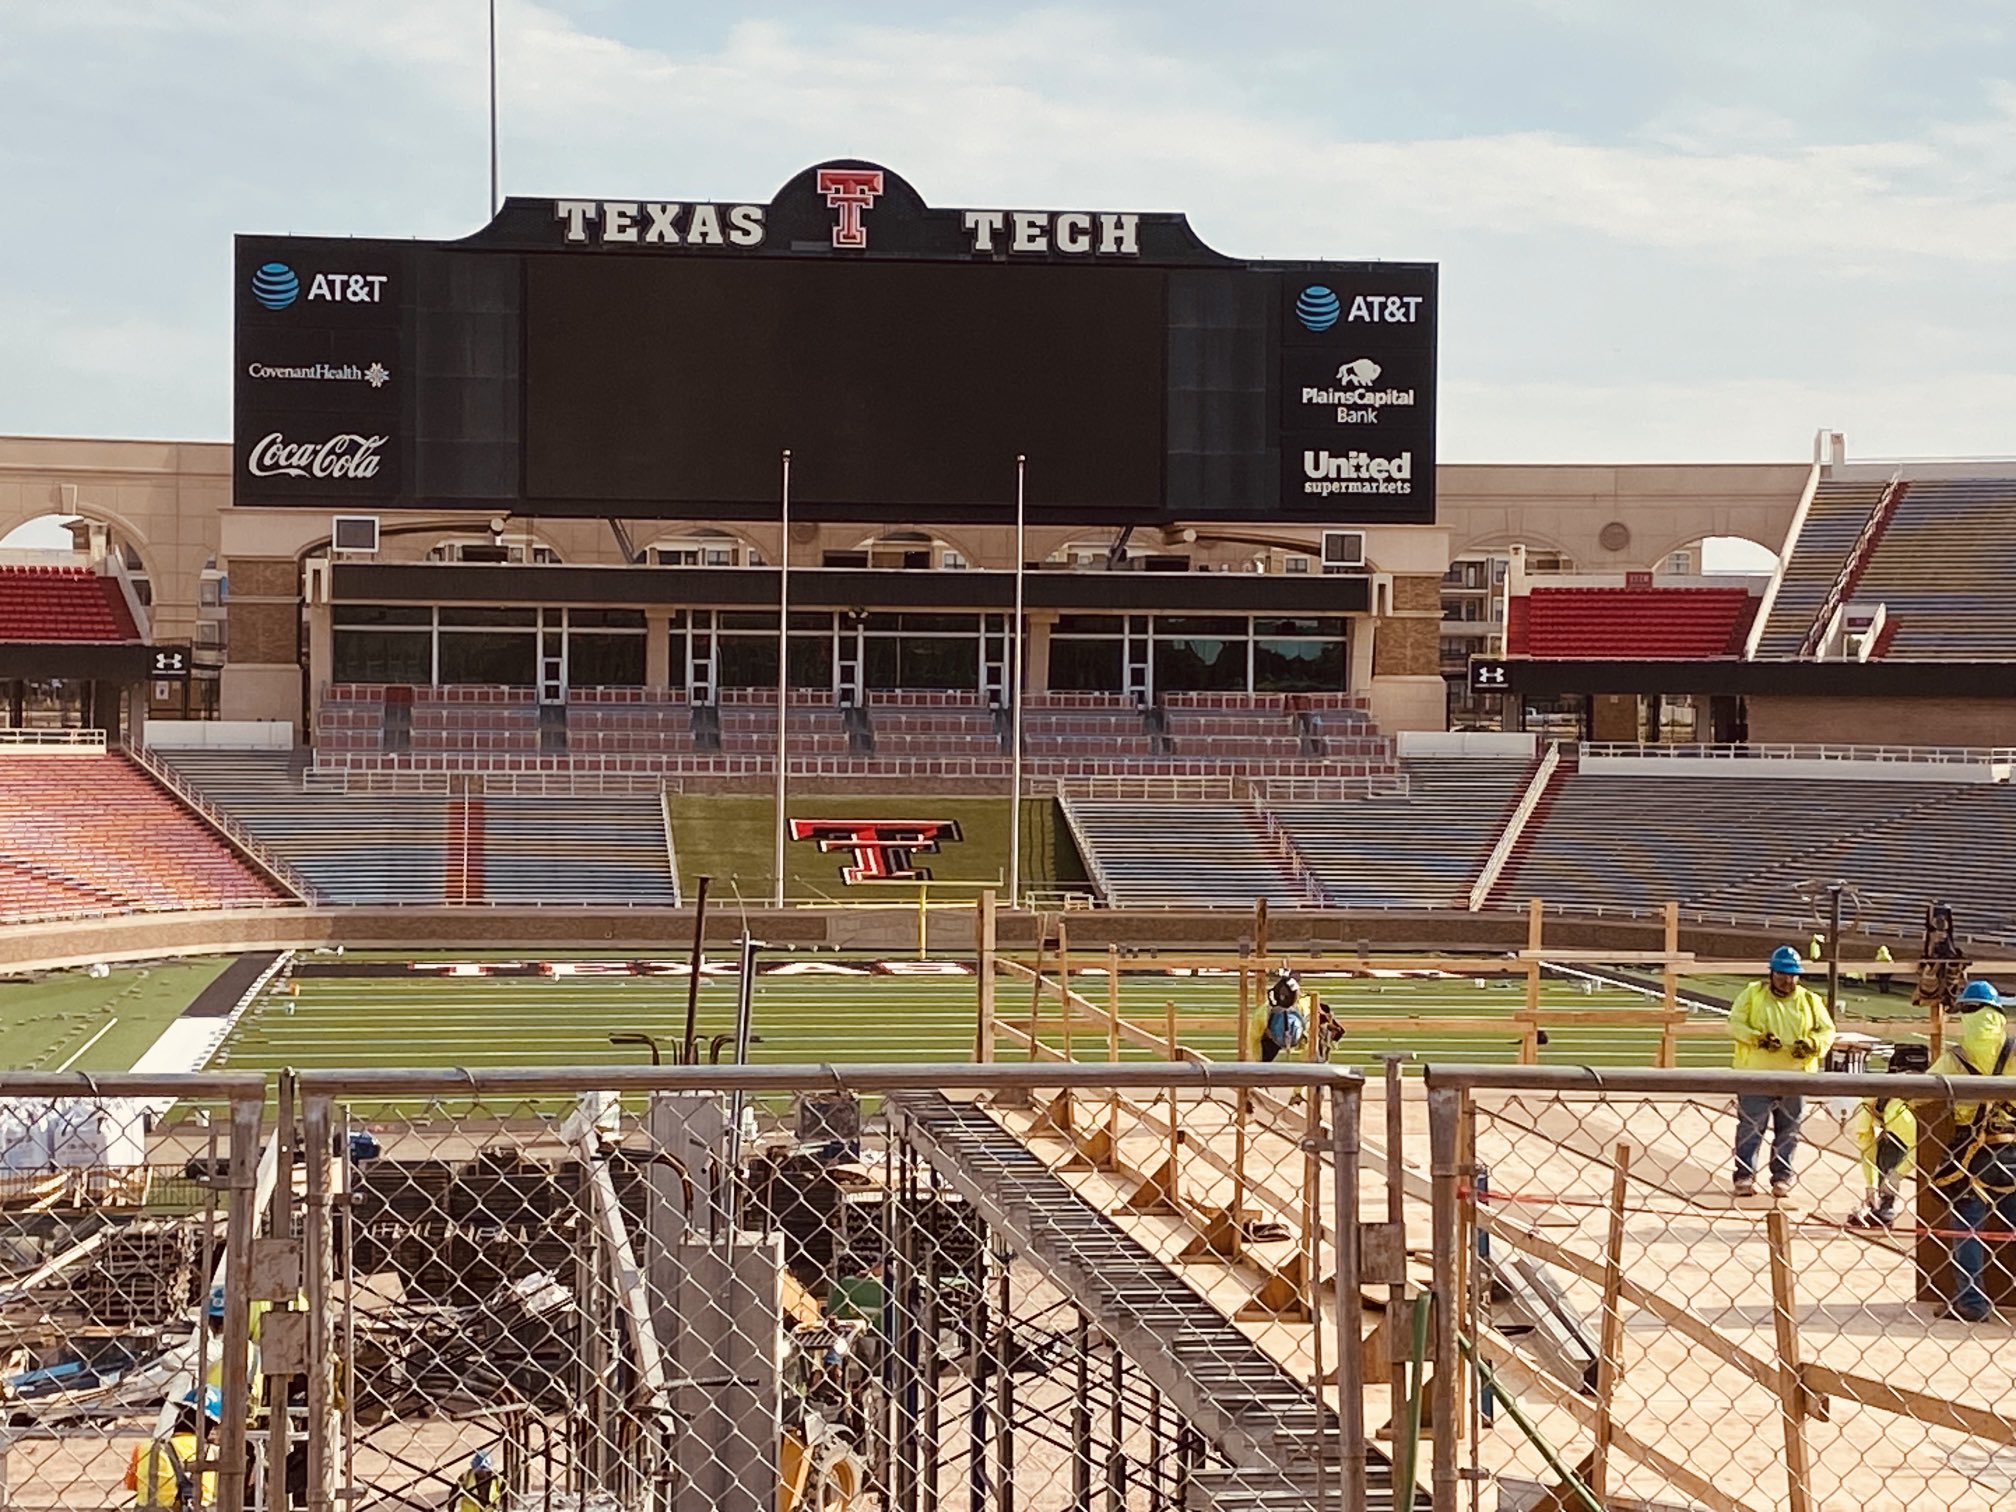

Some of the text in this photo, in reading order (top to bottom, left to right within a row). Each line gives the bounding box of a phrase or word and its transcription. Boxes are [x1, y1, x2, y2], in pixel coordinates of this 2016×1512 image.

[556, 199, 766, 247] TEXAS
[963, 210, 1141, 256] TECH
[307, 273, 388, 303] AT&T
[1347, 295, 1423, 323] AT&T
[1301, 387, 1415, 407] PlainsCapital
[1336, 406, 1378, 424] Bank
[248, 432, 390, 479] Coca-Cola
[1303, 450, 1412, 480] United
[1303, 479, 1412, 497] supermarkets
